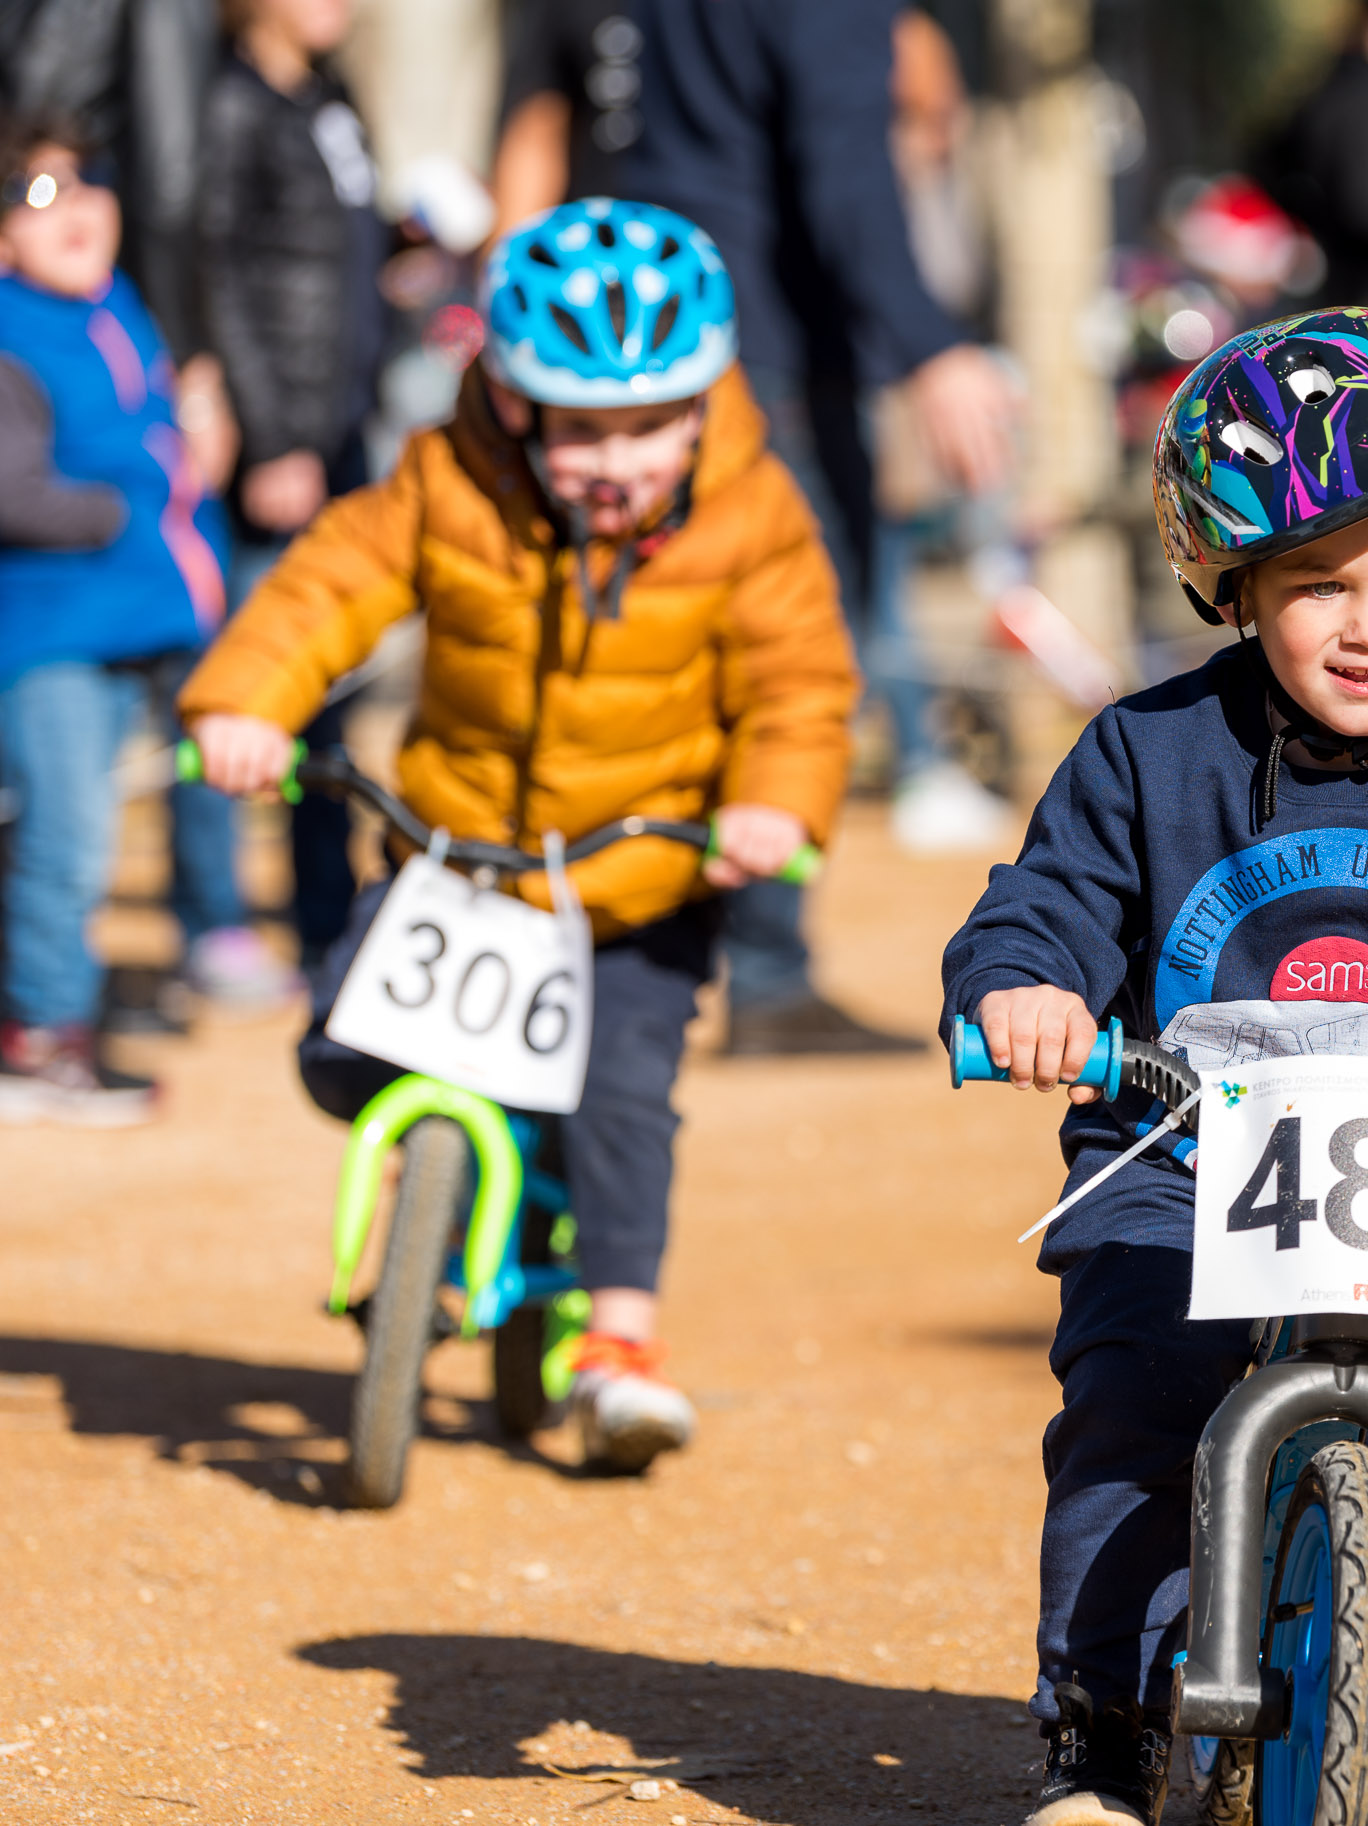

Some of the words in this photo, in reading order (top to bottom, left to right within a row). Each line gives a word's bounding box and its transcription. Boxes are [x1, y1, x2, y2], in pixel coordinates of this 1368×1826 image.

[1168, 843, 1322, 981] NOTTINGHAM
[1286, 960, 1364, 992] sam
[383, 921, 577, 1056] 306
